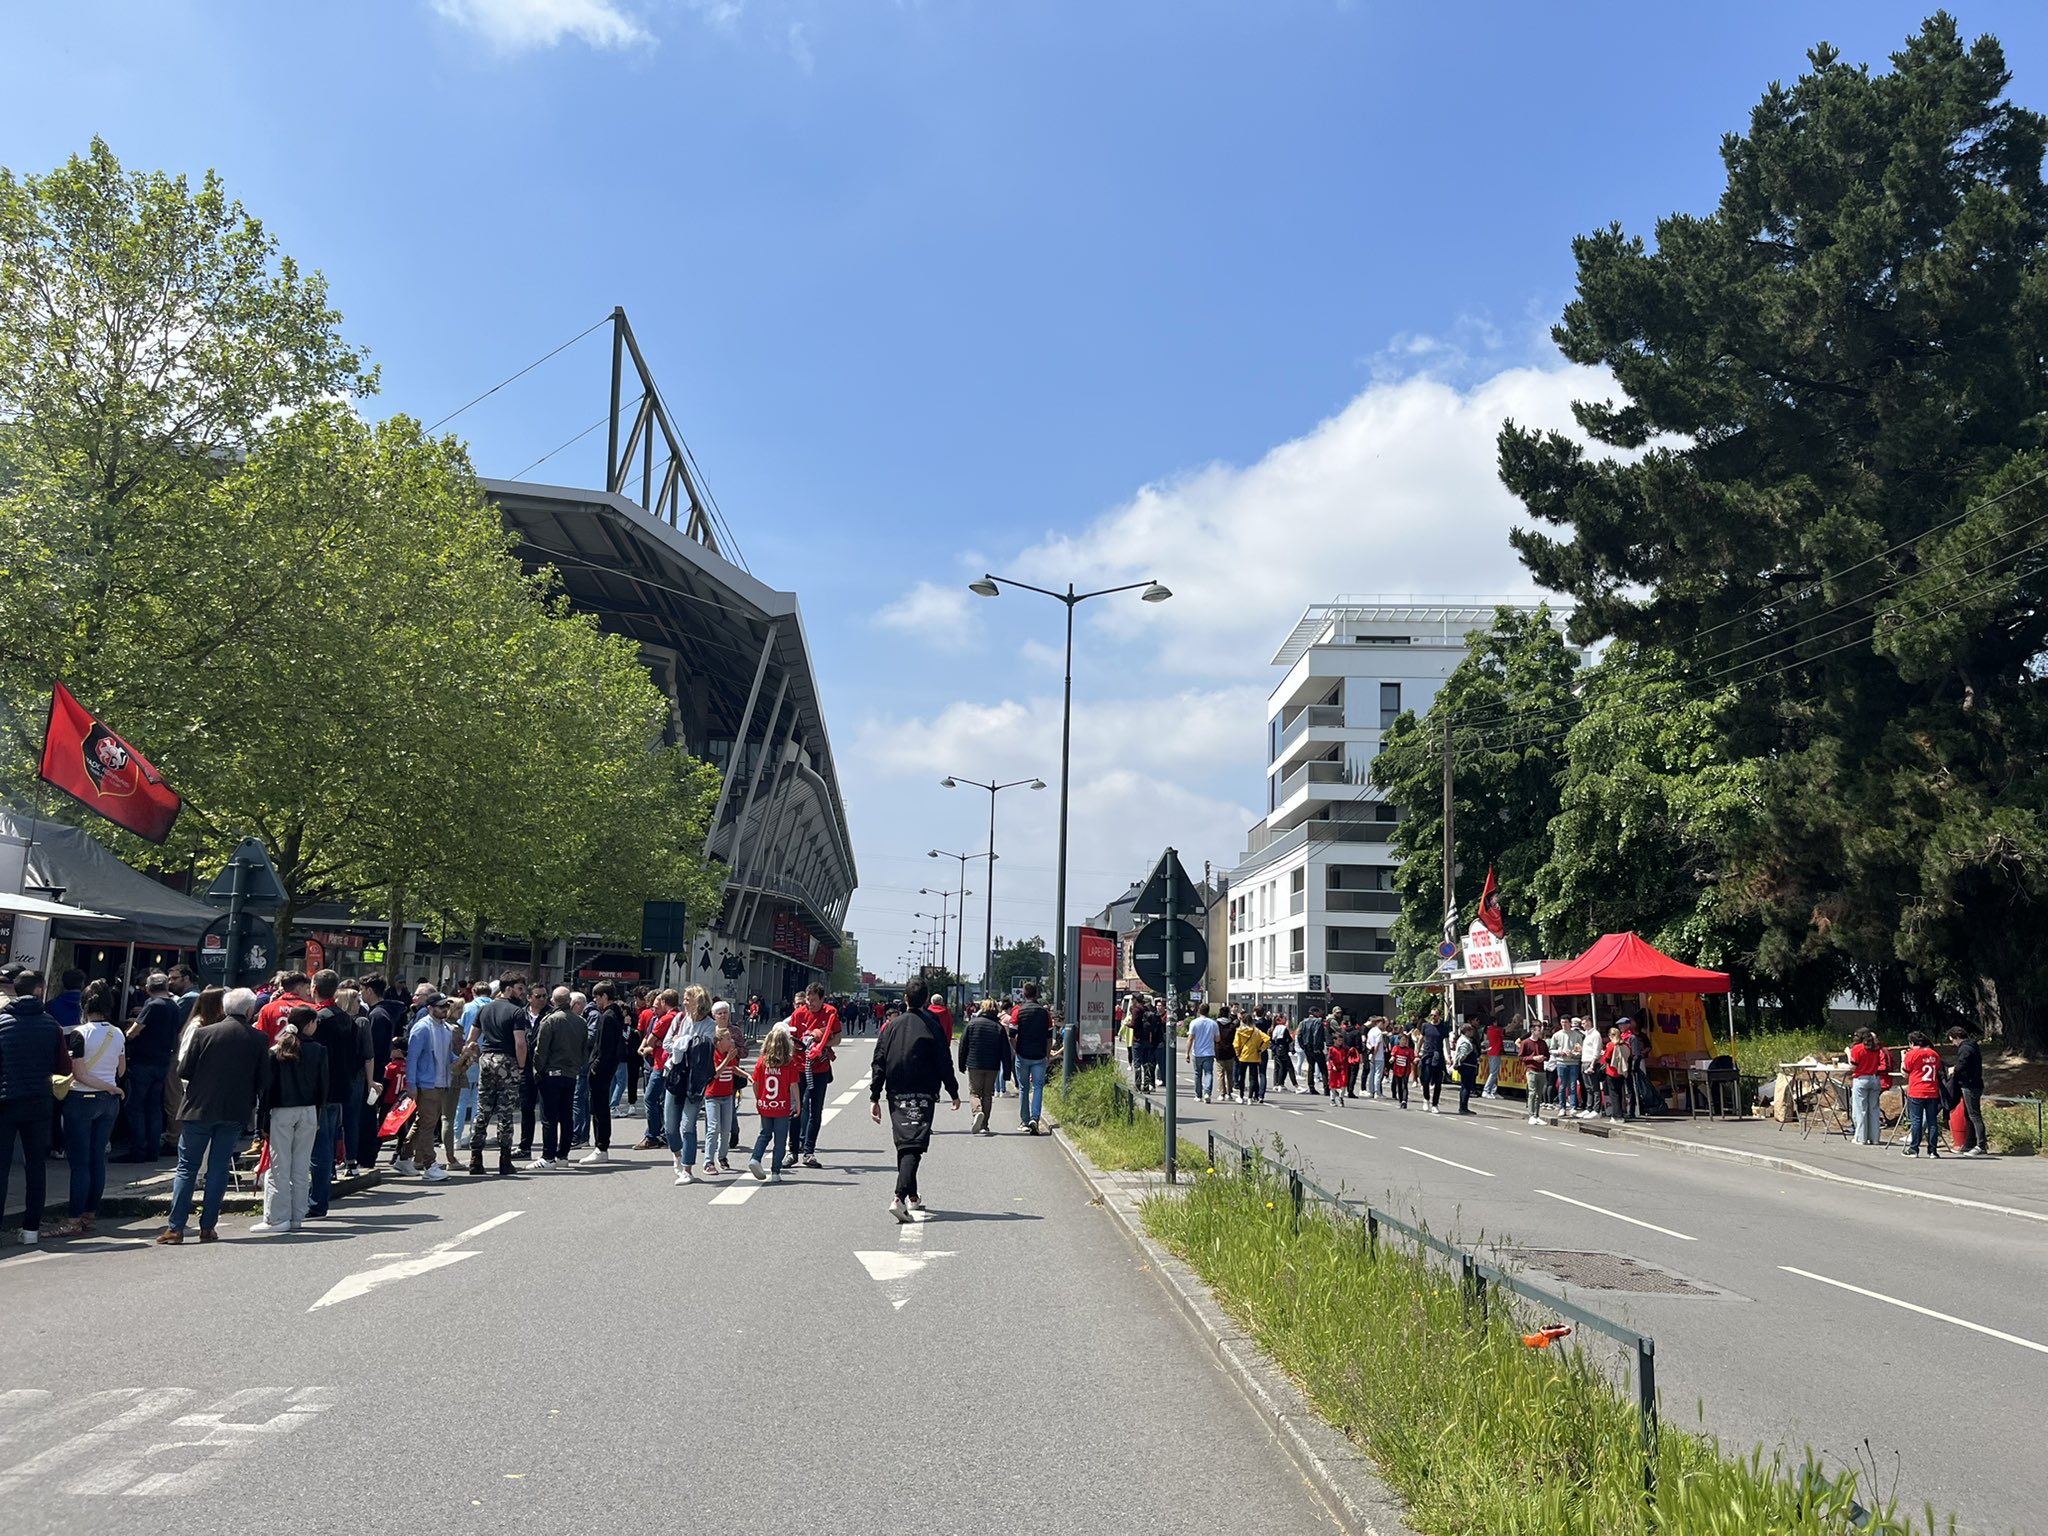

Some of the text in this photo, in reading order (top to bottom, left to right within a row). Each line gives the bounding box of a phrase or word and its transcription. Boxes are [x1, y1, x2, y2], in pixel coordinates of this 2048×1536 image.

[1087, 946, 1111, 959] LAPEYRE
[1490, 977, 1526, 988] FRITES
[1087, 1001, 1105, 1014] RENNES
[1921, 1064, 1936, 1082] 21
[765, 1075, 780, 1100] 9
